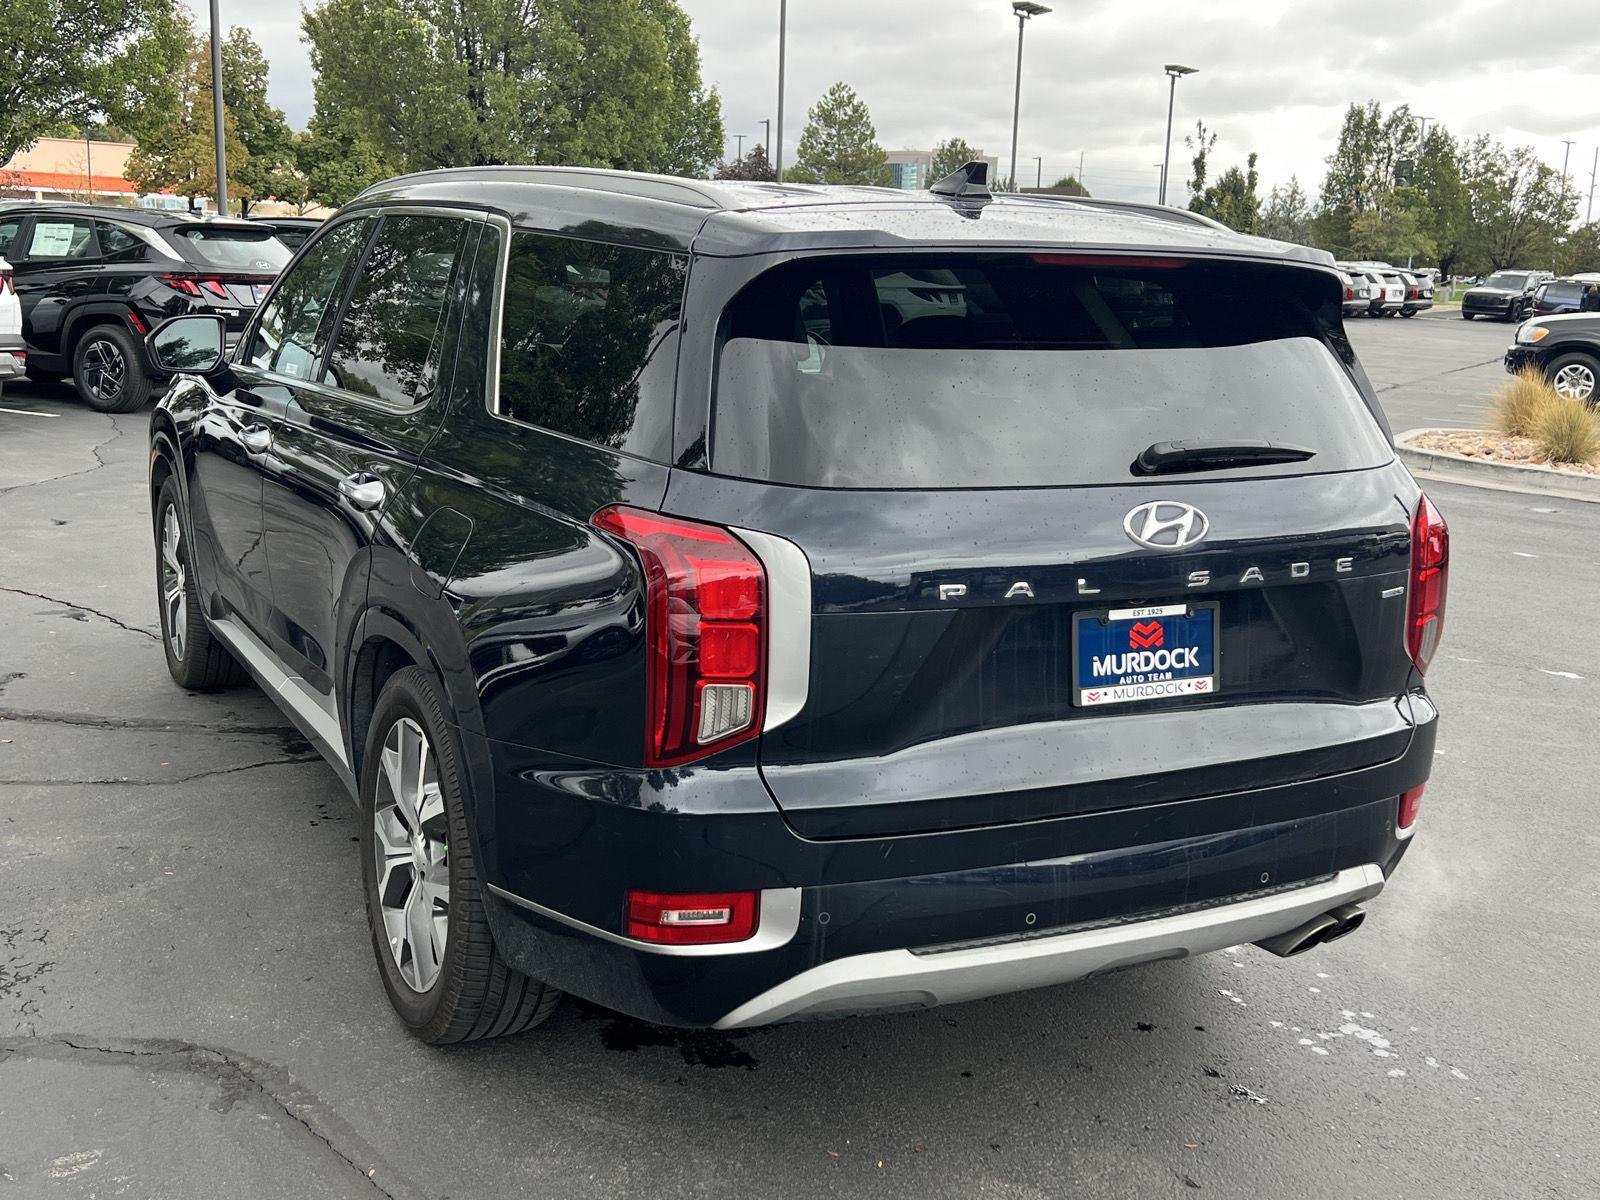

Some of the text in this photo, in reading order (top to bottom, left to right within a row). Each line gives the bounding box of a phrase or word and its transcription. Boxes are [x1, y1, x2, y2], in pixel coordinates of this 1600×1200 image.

[1132, 607, 1163, 617] EST 1925
[1092, 646, 1200, 677] MURDOCK
[1119, 671, 1173, 685] AUTO TEAM
[1113, 682, 1184, 700] MURDOCK
